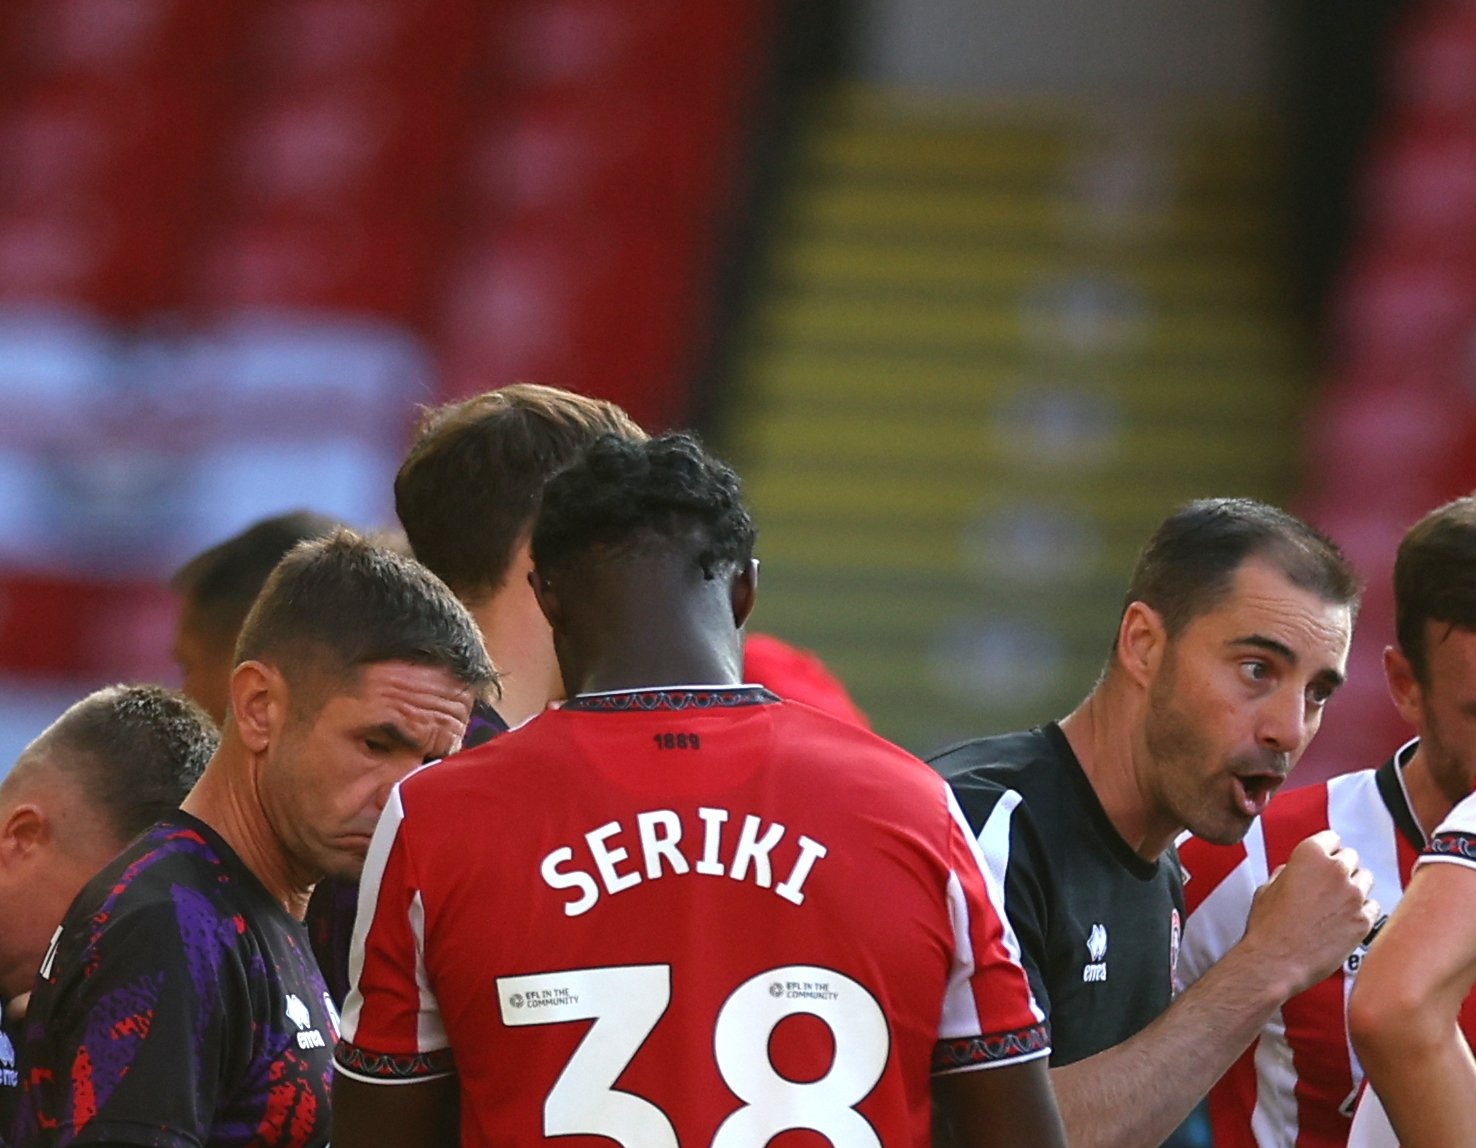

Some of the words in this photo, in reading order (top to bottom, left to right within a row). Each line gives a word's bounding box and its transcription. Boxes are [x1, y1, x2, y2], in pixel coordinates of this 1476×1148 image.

[653, 732, 700, 750] 1889
[540, 806, 827, 917] SERIKI
[525, 991, 540, 1000] EFL
[554, 988, 569, 997] THE
[786, 990, 839, 1000] COMMUNITY
[527, 996, 579, 1008] COMMUNITY
